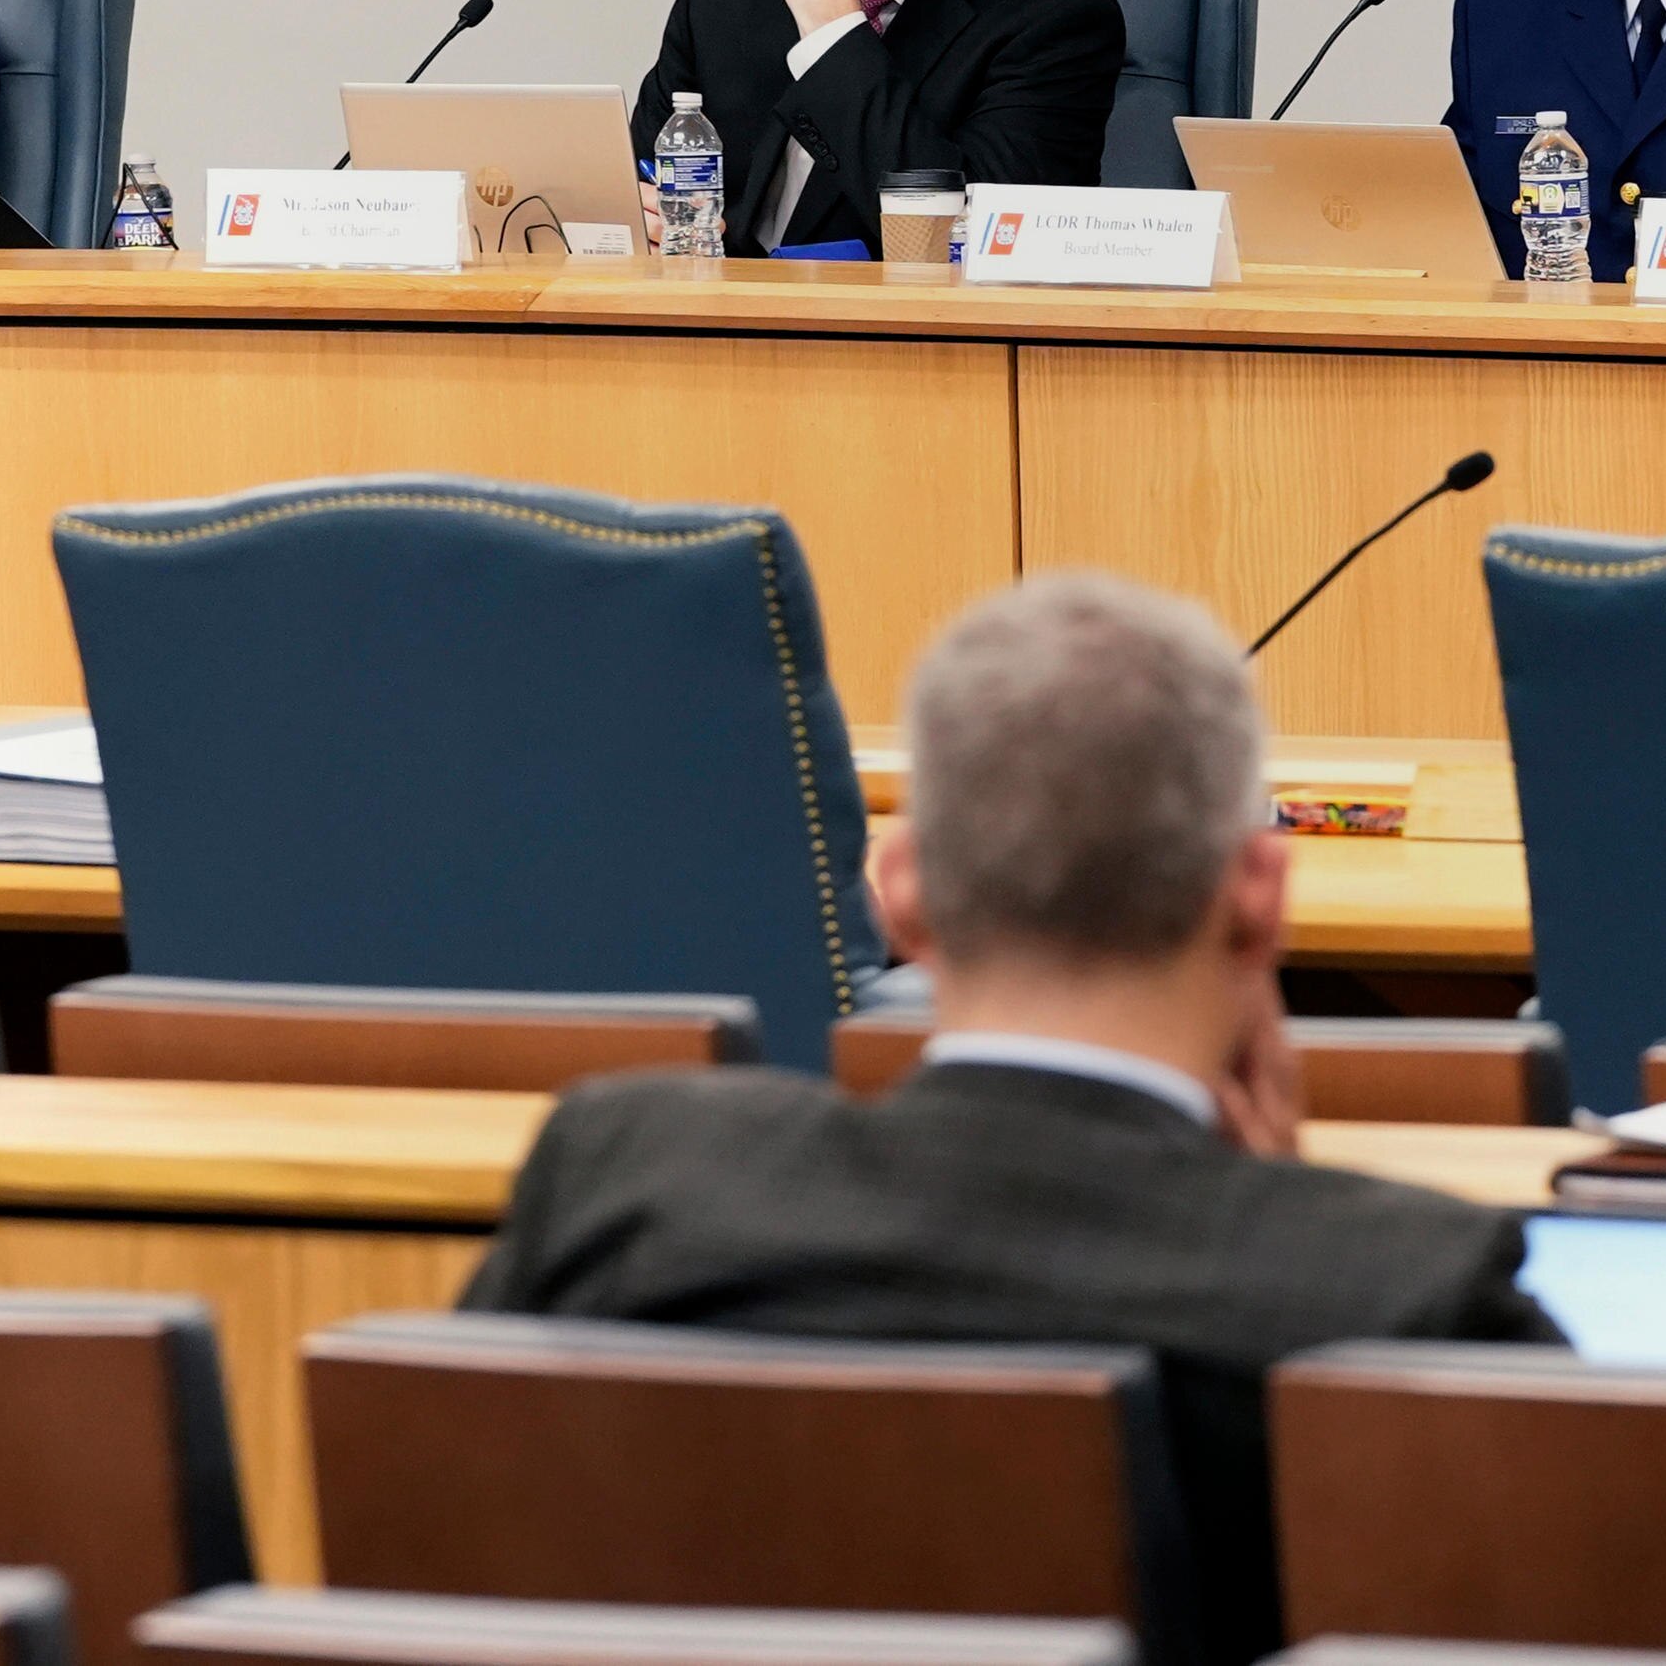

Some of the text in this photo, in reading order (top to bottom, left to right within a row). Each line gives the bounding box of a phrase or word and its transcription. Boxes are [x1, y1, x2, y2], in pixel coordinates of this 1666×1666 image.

[357, 198, 421, 212] Neubau
[125, 222, 160, 234] DEER
[1036, 215, 1194, 233] LCDR Thomas Whalen
[125, 234, 162, 246] PARK
[1064, 241, 1153, 258] Board Member
